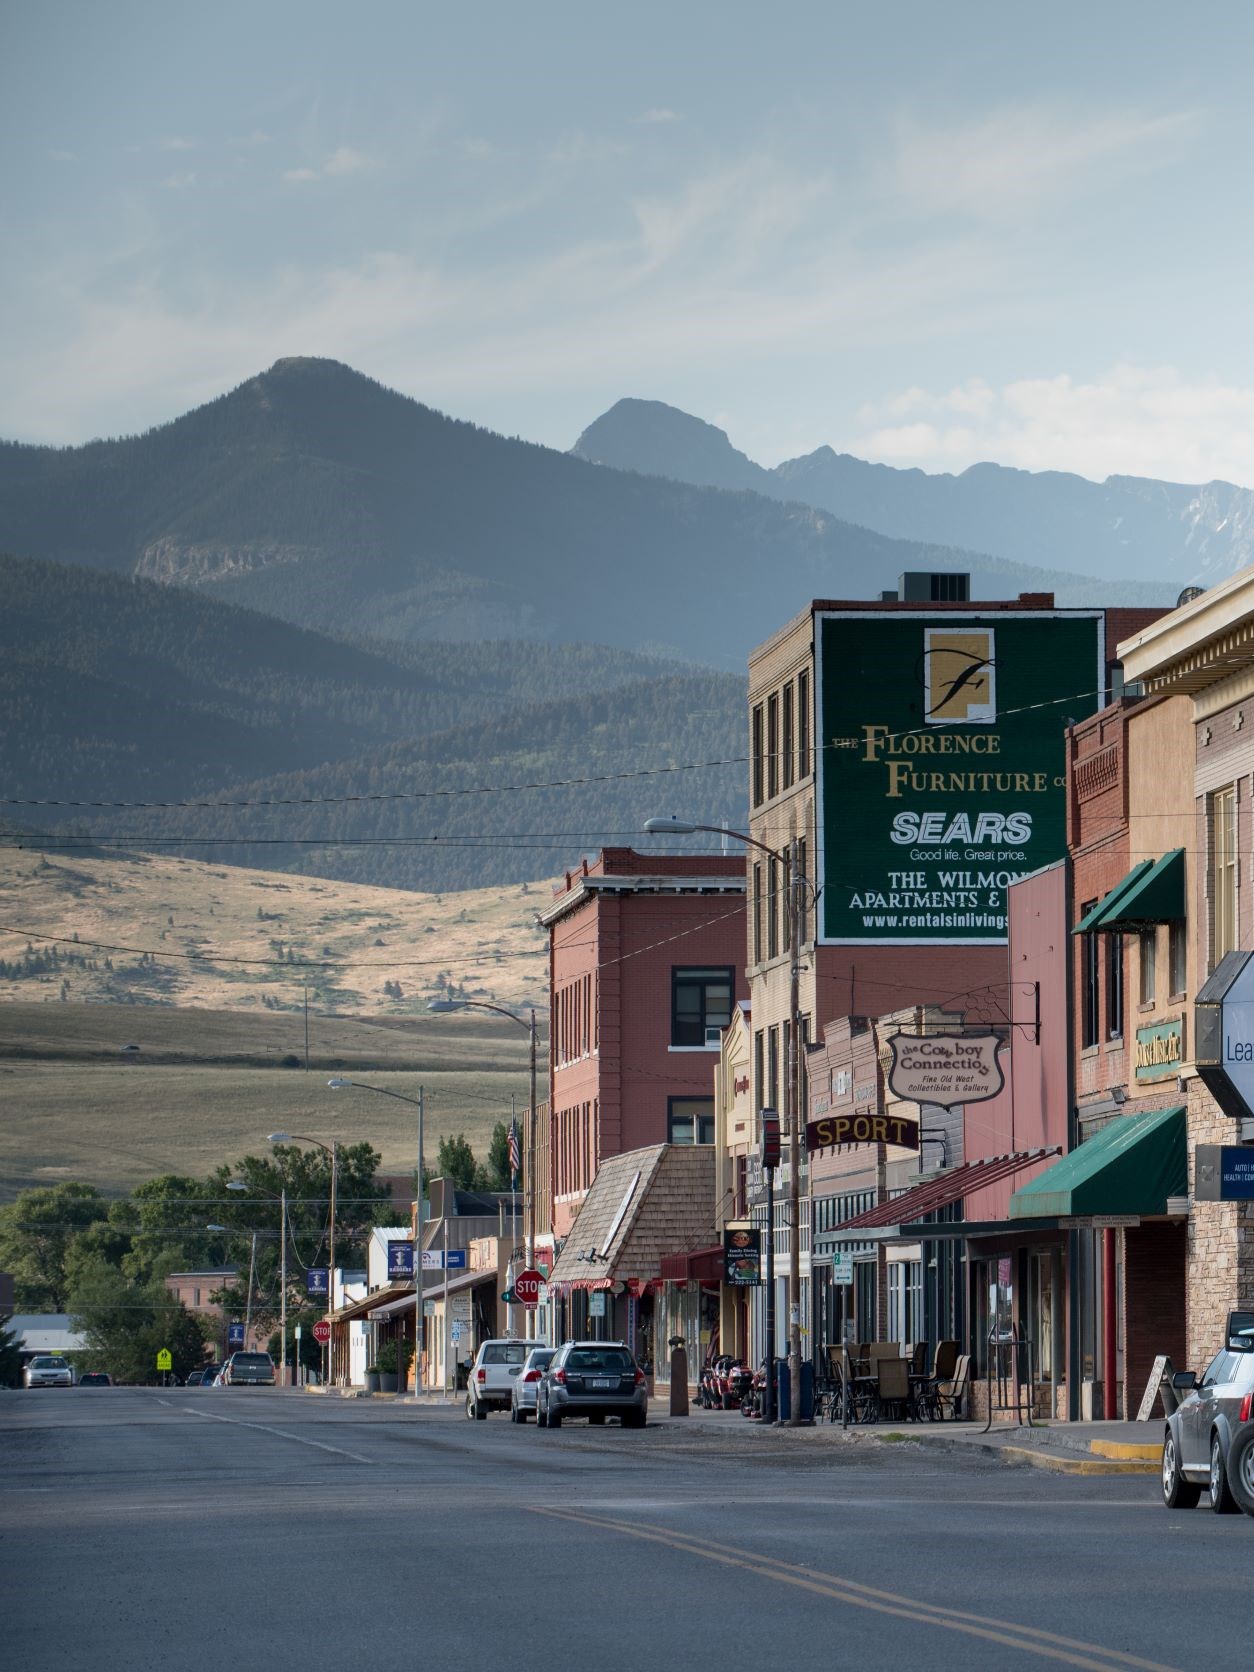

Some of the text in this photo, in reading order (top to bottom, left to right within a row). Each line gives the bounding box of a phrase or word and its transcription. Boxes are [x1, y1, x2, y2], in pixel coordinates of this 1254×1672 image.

[831, 725, 1001, 761] THE FLORENCE
[885, 761, 1047, 797] FURNITURE
[890, 811, 1033, 844] SEARS
[910, 849, 1027, 863] Good life. Great price.
[888, 872, 1029, 889] THE WILMO
[849, 892, 1000, 908] APARTMENTS &
[902, 1045, 919, 1056] the
[900, 1057, 989, 1076] Connection
[922, 1075, 975, 1083] Fine Old West
[908, 1084, 952, 1092] Collectibles
[963, 1084, 990, 1094] Gallery
[816, 1116, 909, 1147] SPORT
[1234, 1163, 1248, 1172] AUTO
[1223, 1173, 1241, 1181] HEALTH
